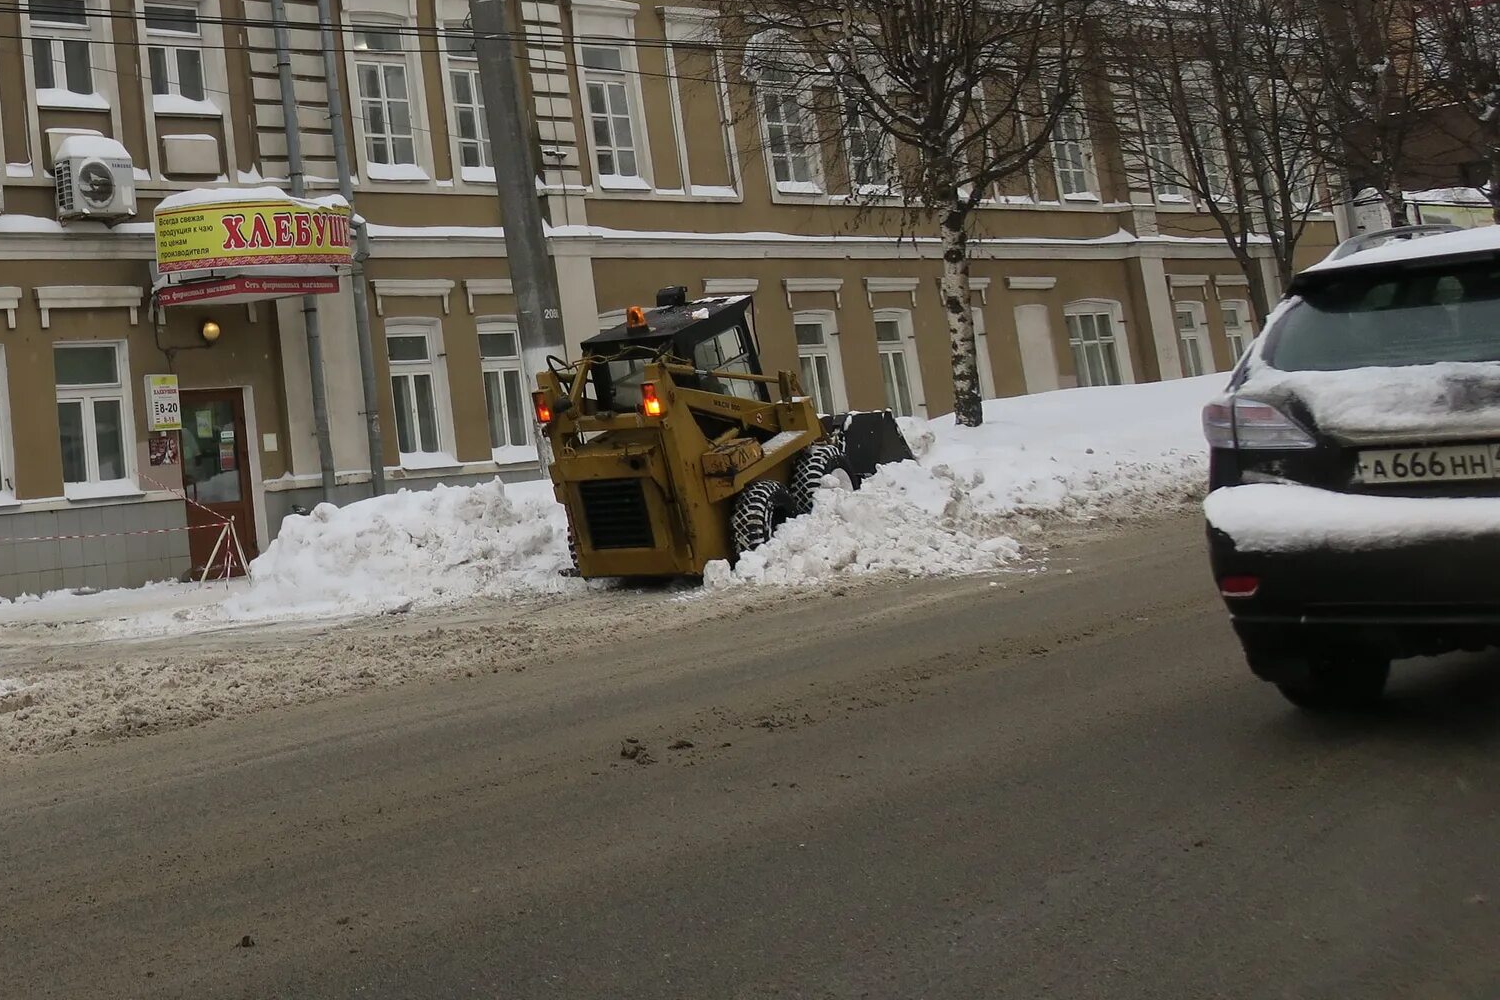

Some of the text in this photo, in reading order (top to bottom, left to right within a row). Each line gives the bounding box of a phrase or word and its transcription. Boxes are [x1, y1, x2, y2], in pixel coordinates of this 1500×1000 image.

[159, 215, 204, 226] Всегда свежая
[160, 227, 191, 237] продукция
[169, 239, 187, 247] ценам
[161, 248, 209, 258] производителя
[244, 281, 260, 289] Сеть
[262, 281, 300, 290] фирменных
[172, 288, 205, 300] фирменных
[206, 284, 236, 294] магазинов
[160, 402, 178, 413] 8-20
